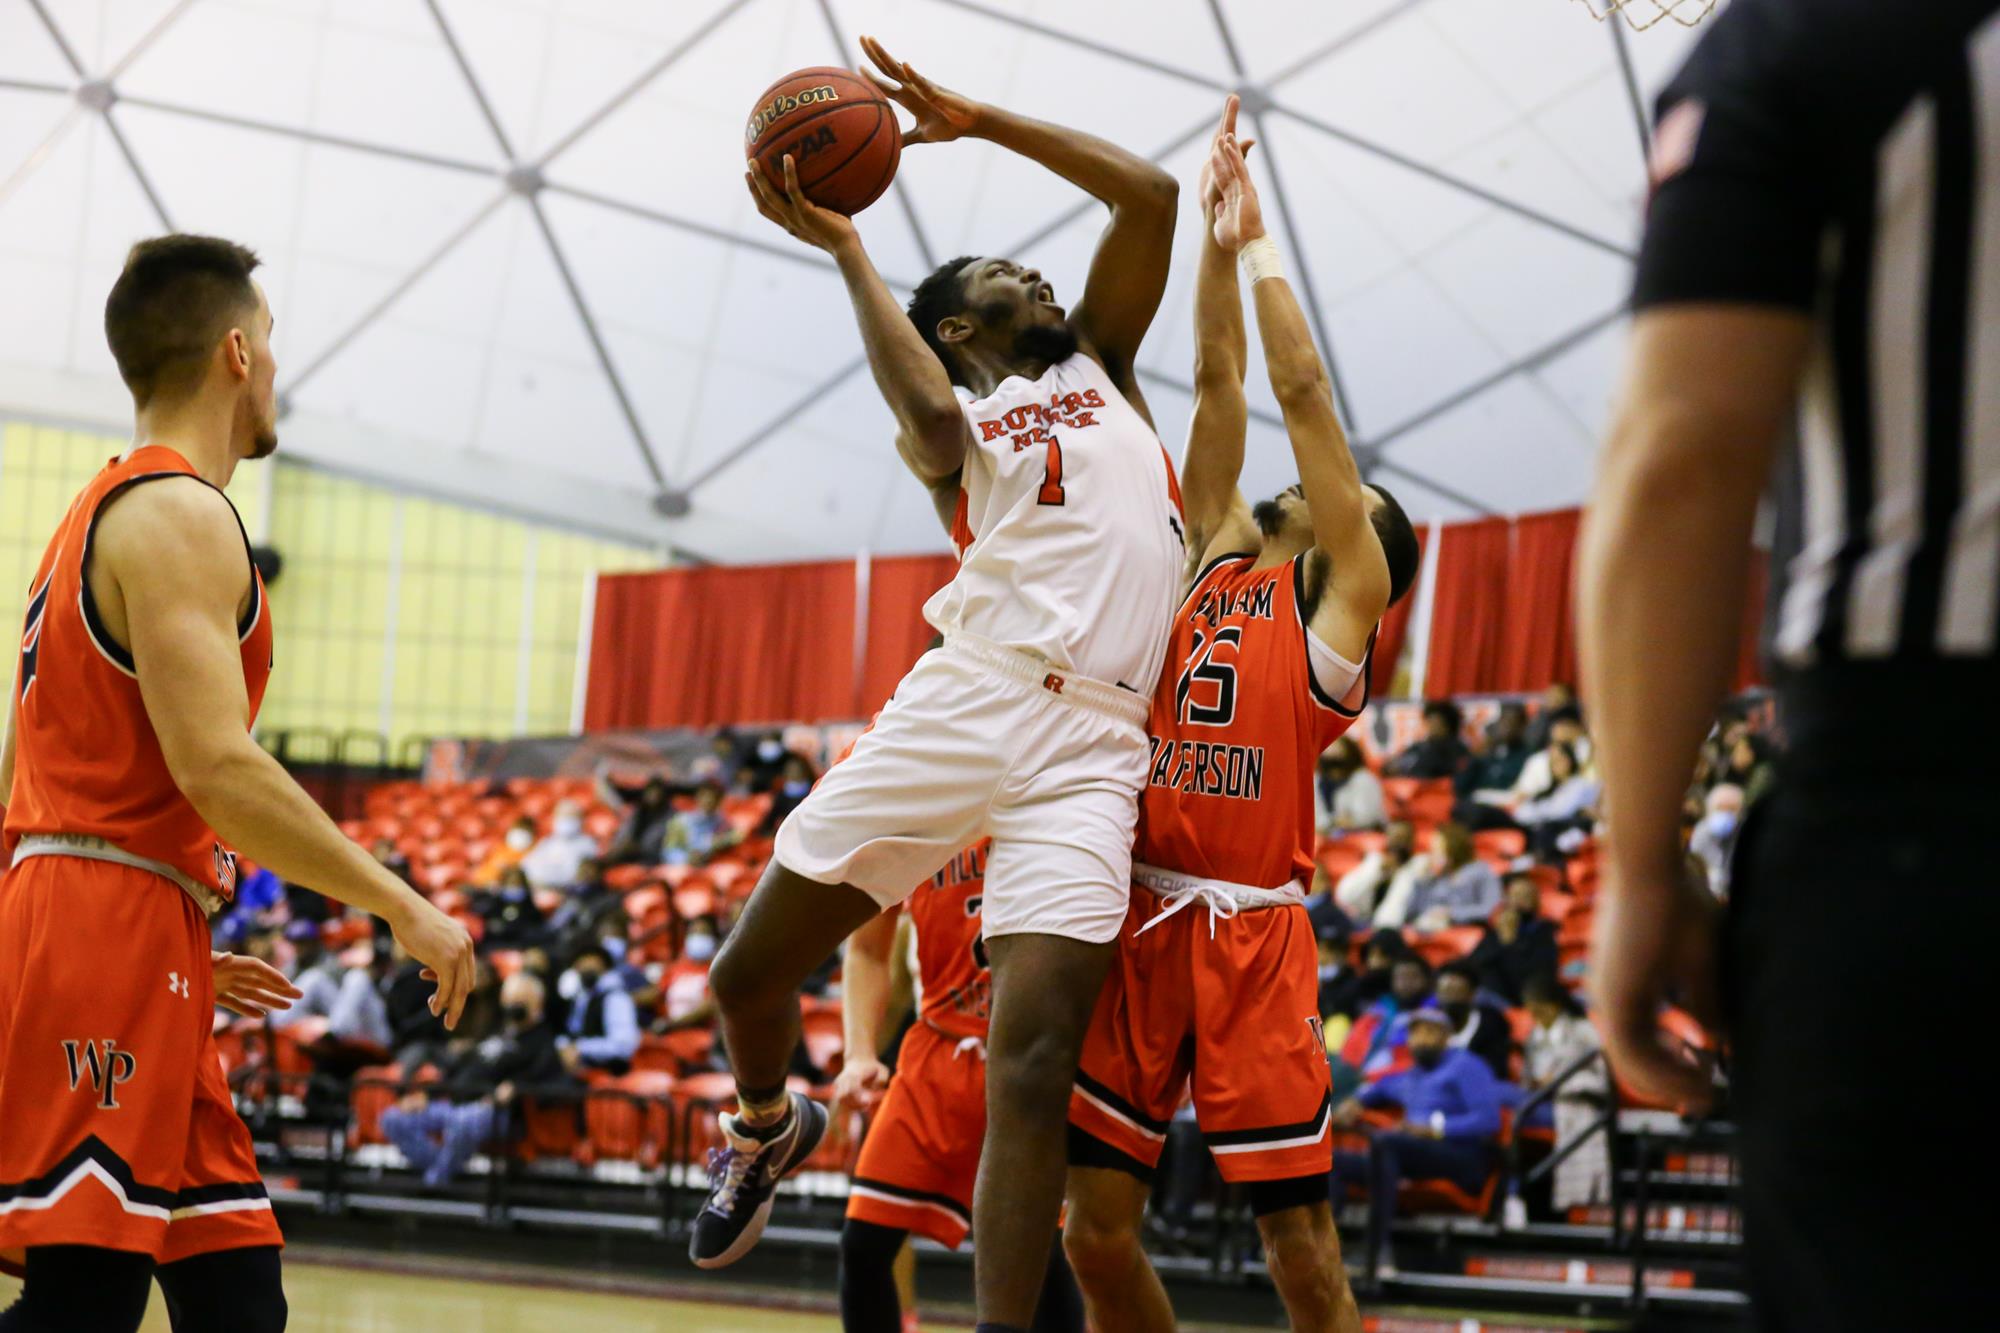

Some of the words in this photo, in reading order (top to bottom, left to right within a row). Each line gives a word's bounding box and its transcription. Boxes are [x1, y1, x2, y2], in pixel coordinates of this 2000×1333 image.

[977, 388, 1106, 442] RUTRS
[1036, 434, 1065, 506] 1
[1042, 672, 1065, 695] R
[61, 1039, 136, 1109] WP
